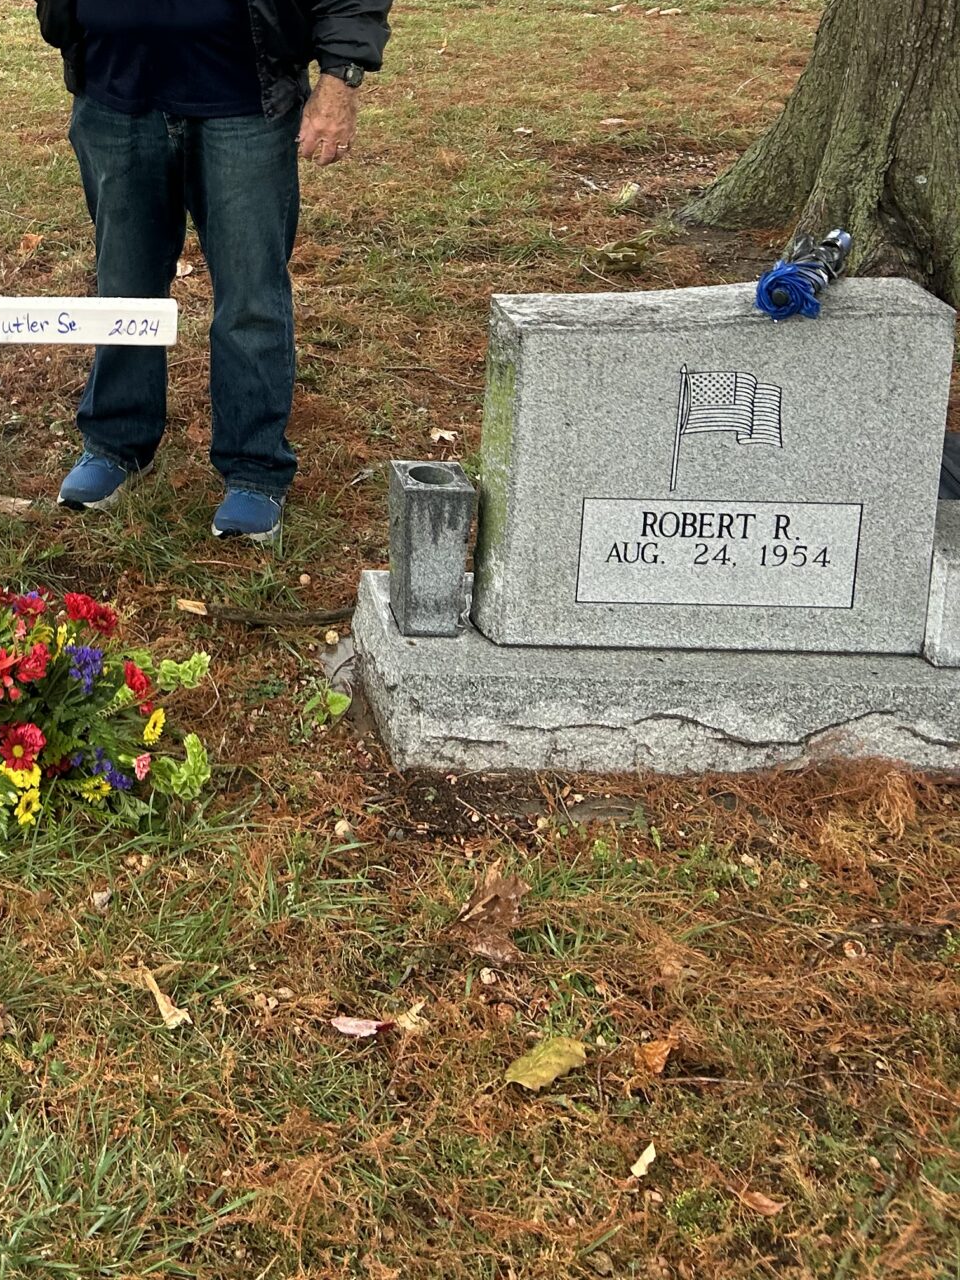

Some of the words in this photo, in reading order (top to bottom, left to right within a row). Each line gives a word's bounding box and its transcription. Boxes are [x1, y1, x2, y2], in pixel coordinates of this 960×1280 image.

[108, 319, 159, 336] 2024
[640, 511, 757, 540] ROBERT
[773, 514, 800, 541] R.
[604, 542, 665, 565] AUG.
[693, 543, 737, 568] 24,
[760, 545, 831, 568] 1954
